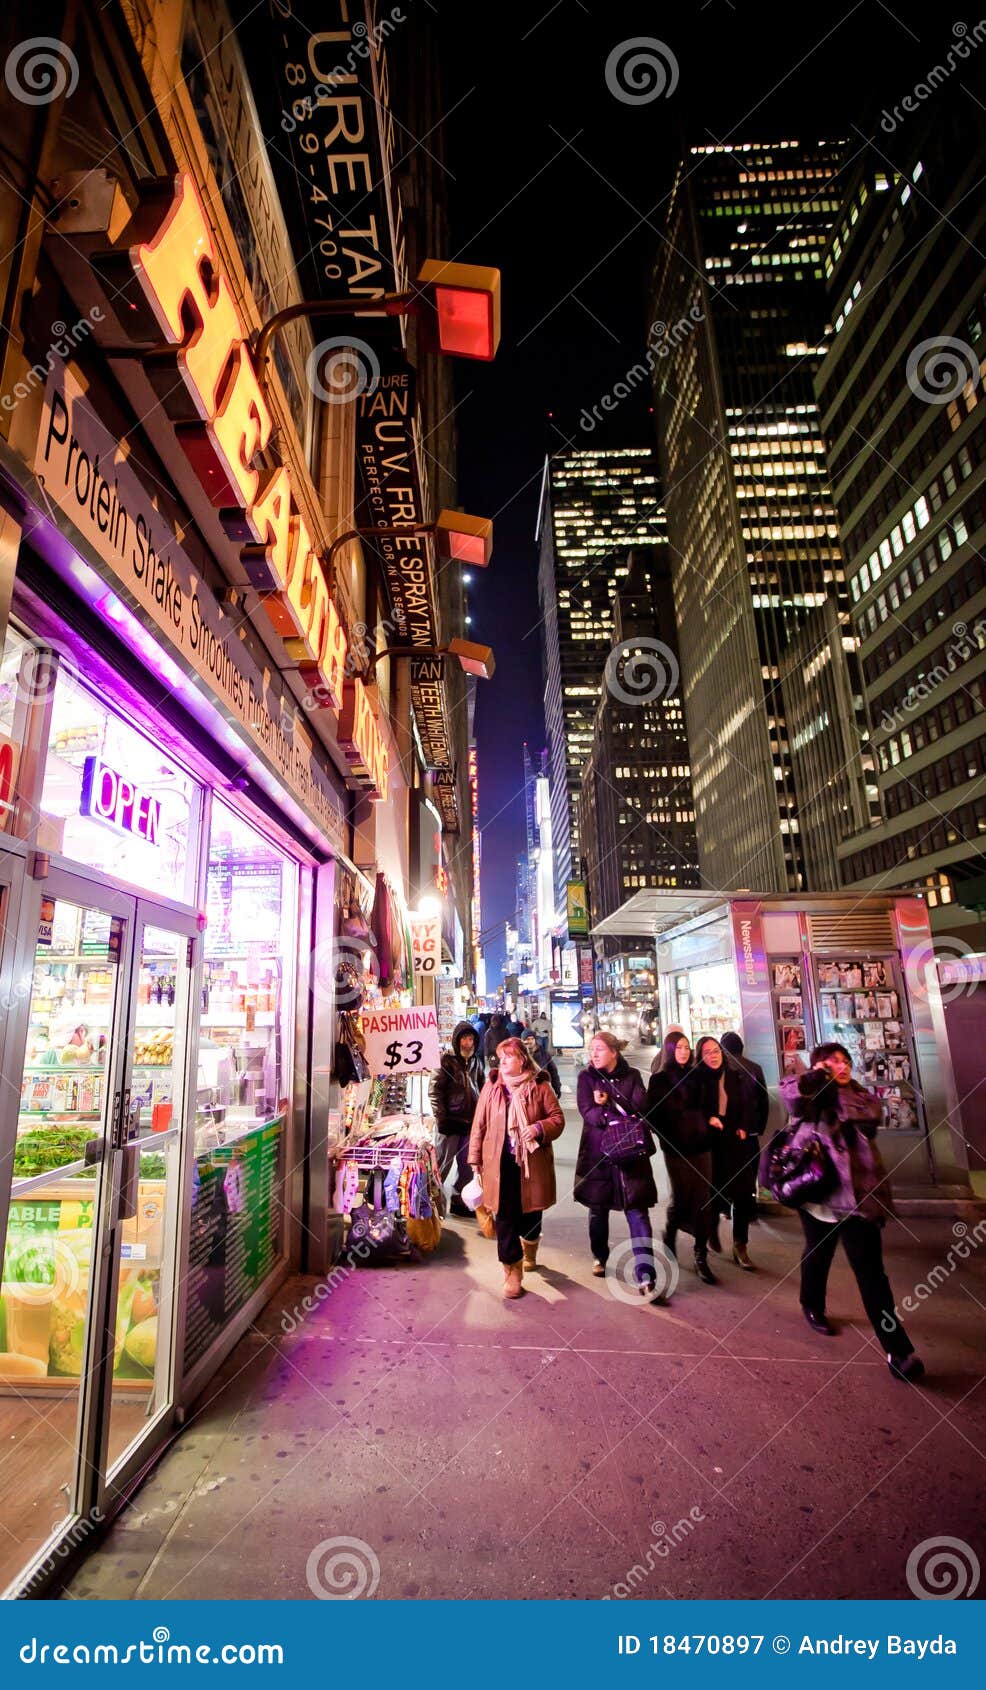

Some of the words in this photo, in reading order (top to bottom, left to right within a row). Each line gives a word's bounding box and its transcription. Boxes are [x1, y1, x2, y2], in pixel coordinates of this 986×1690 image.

[307, 0, 374, 195] URE
[359, 390, 408, 417] TAN
[131, 172, 348, 710] HEALTH
[374, 421, 410, 478] U.V.
[45, 389, 128, 558] Protein
[132, 513, 185, 641] Shake,
[361, 444, 385, 513] PERFECT
[377, 519, 395, 563] CLOR
[400, 556, 429, 618] SPRAY
[410, 620, 431, 647] TAN
[411, 662, 441, 679] TAN
[419, 681, 442, 717] TEETH
[426, 719, 449, 766] WHITENING
[97, 765, 162, 847] OPEN
[413, 939, 436, 953] AG
[741, 920, 758, 985] Newsstand
[362, 1011, 437, 1034] PASHMINA
[383, 1040, 424, 1070] $3
